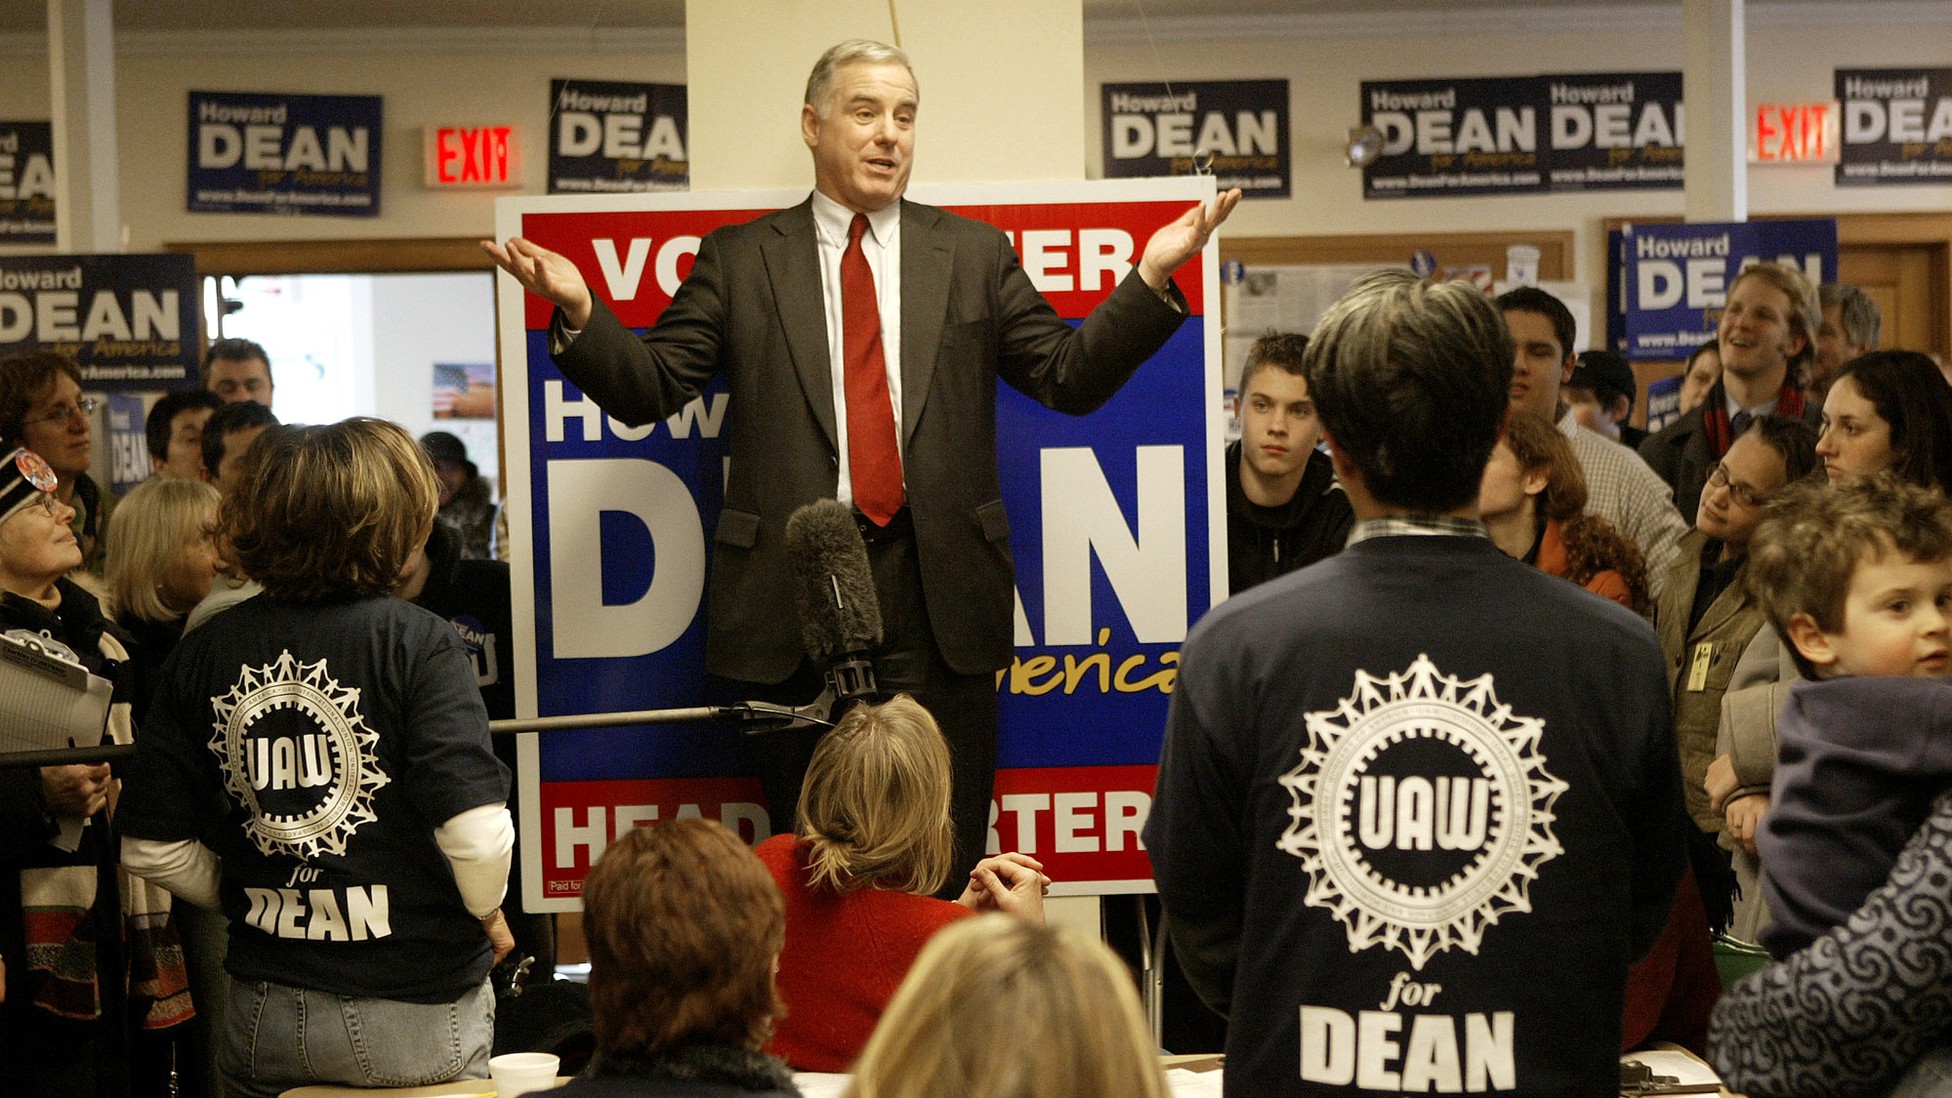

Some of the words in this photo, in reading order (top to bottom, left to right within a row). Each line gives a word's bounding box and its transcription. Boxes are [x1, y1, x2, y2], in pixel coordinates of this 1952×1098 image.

[560, 91, 647, 113] Howard
[1111, 92, 1197, 113] Howard
[1372, 87, 1455, 111] Howard
[1552, 82, 1634, 105] Howard
[1846, 76, 1928, 98] Howard
[201, 102, 287, 125] Howard
[558, 111, 687, 161] DEA
[1111, 111, 1279, 159] DEAN
[1373, 106, 1536, 156] DEAN
[1552, 101, 1684, 150] DEA
[1756, 104, 1828, 160] EXIT
[1845, 97, 1952, 144] DEA
[200, 123, 369, 173] DEAN
[437, 126, 511, 183] EXIT
[1637, 232, 1730, 258] Howard
[0, 266, 83, 289] oward
[1637, 253, 1822, 311] DE
[0, 288, 181, 344] DEAN
[996, 627, 1183, 695] erica
[246, 733, 333, 791] UAW
[1358, 775, 1490, 851] UAW
[286, 861, 324, 889] for
[550, 881, 569, 891] Paid
[244, 884, 393, 942] DEAN
[1380, 970, 1442, 1012] for
[1299, 1004, 1517, 1094] DEAN
